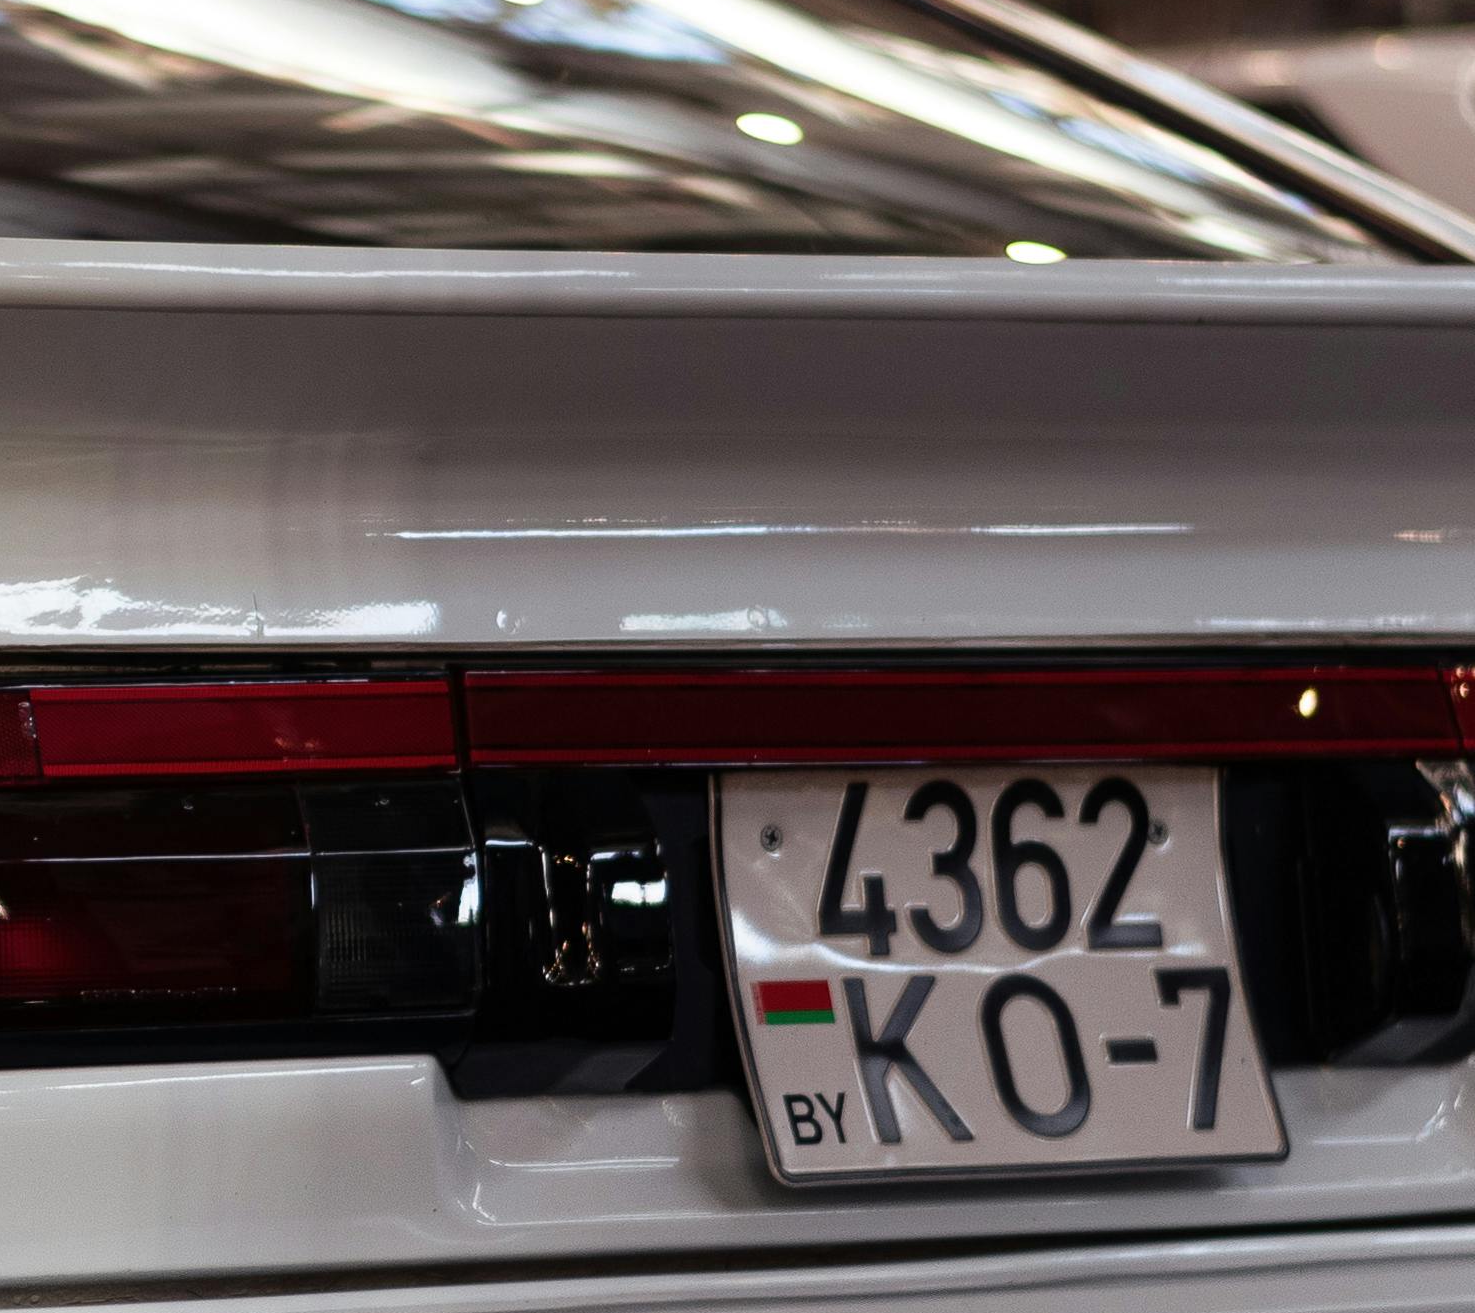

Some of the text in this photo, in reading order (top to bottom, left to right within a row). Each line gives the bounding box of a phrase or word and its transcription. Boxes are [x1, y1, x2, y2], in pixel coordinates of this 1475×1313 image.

[817, 779, 1163, 954] 4362
[783, 1092, 845, 1145] BY
[843, 968, 1231, 1144] KO-7
